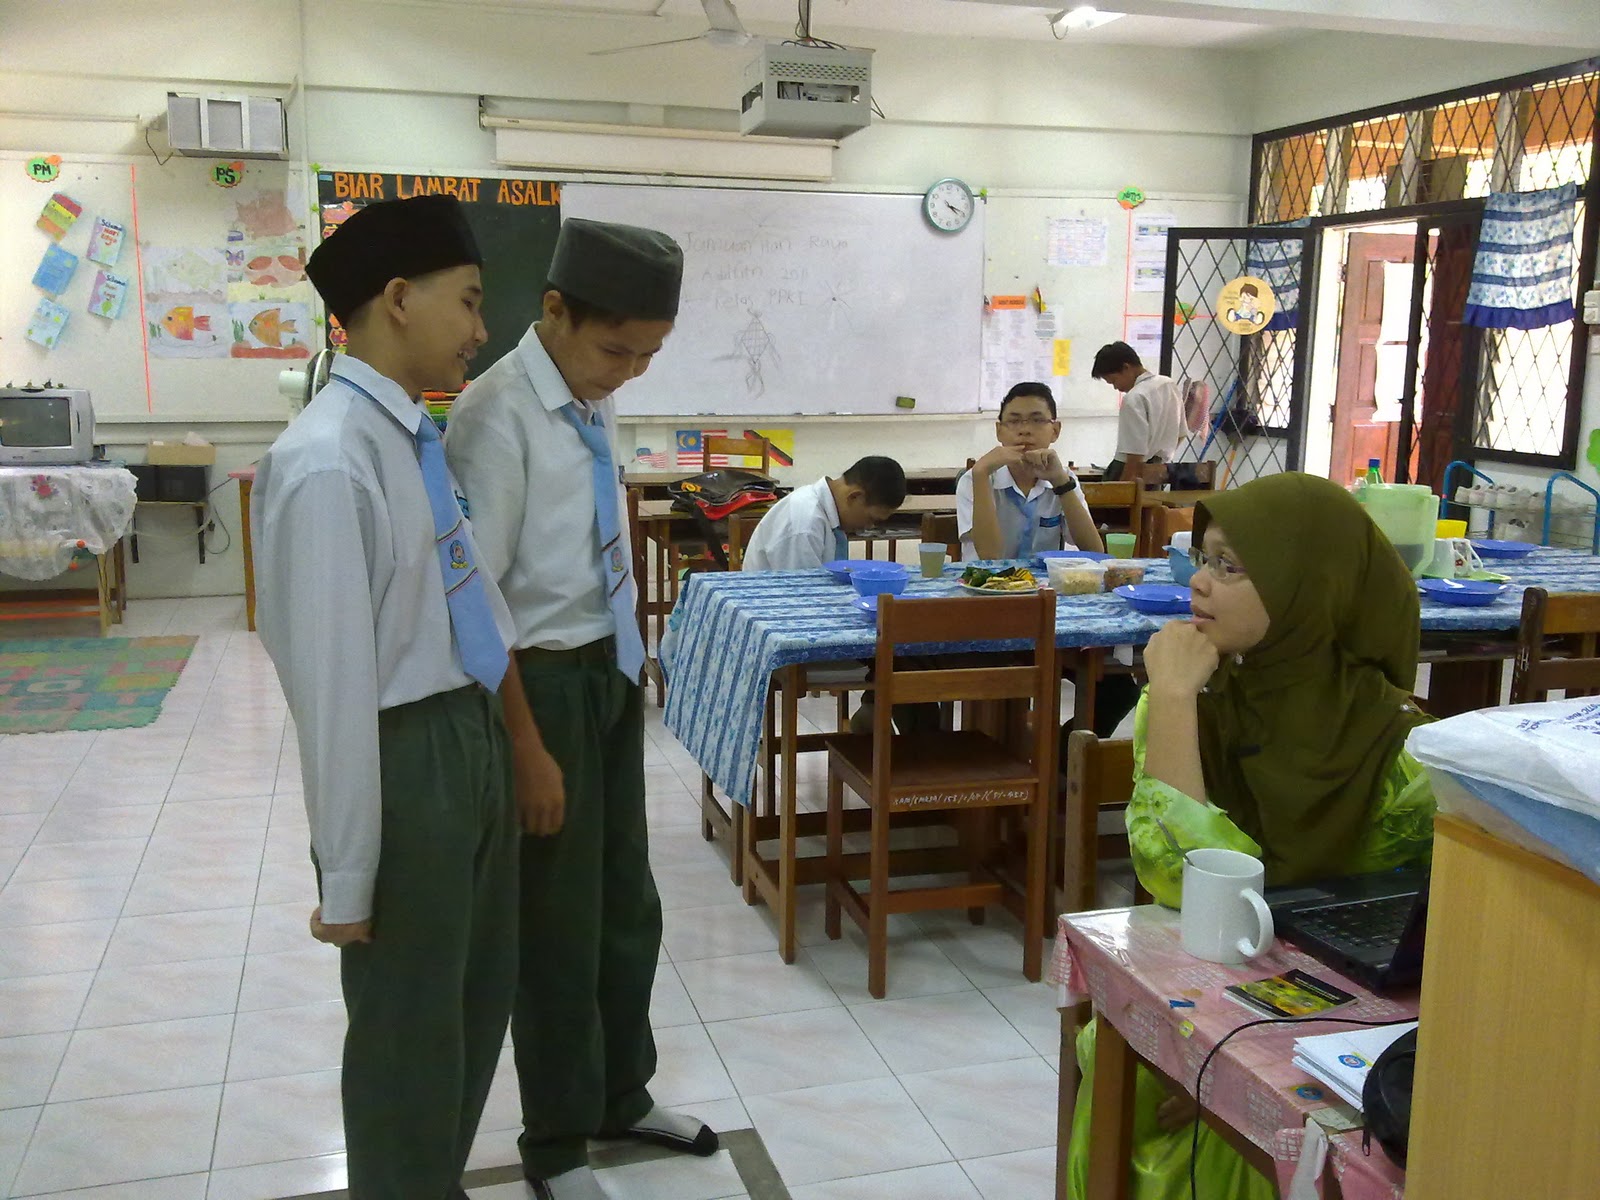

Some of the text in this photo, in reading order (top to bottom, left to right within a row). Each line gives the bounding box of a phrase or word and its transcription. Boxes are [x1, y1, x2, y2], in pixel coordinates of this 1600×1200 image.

[33, 163, 52, 176] PM
[216, 167, 236, 184] PS
[334, 172, 384, 199] BIAR
